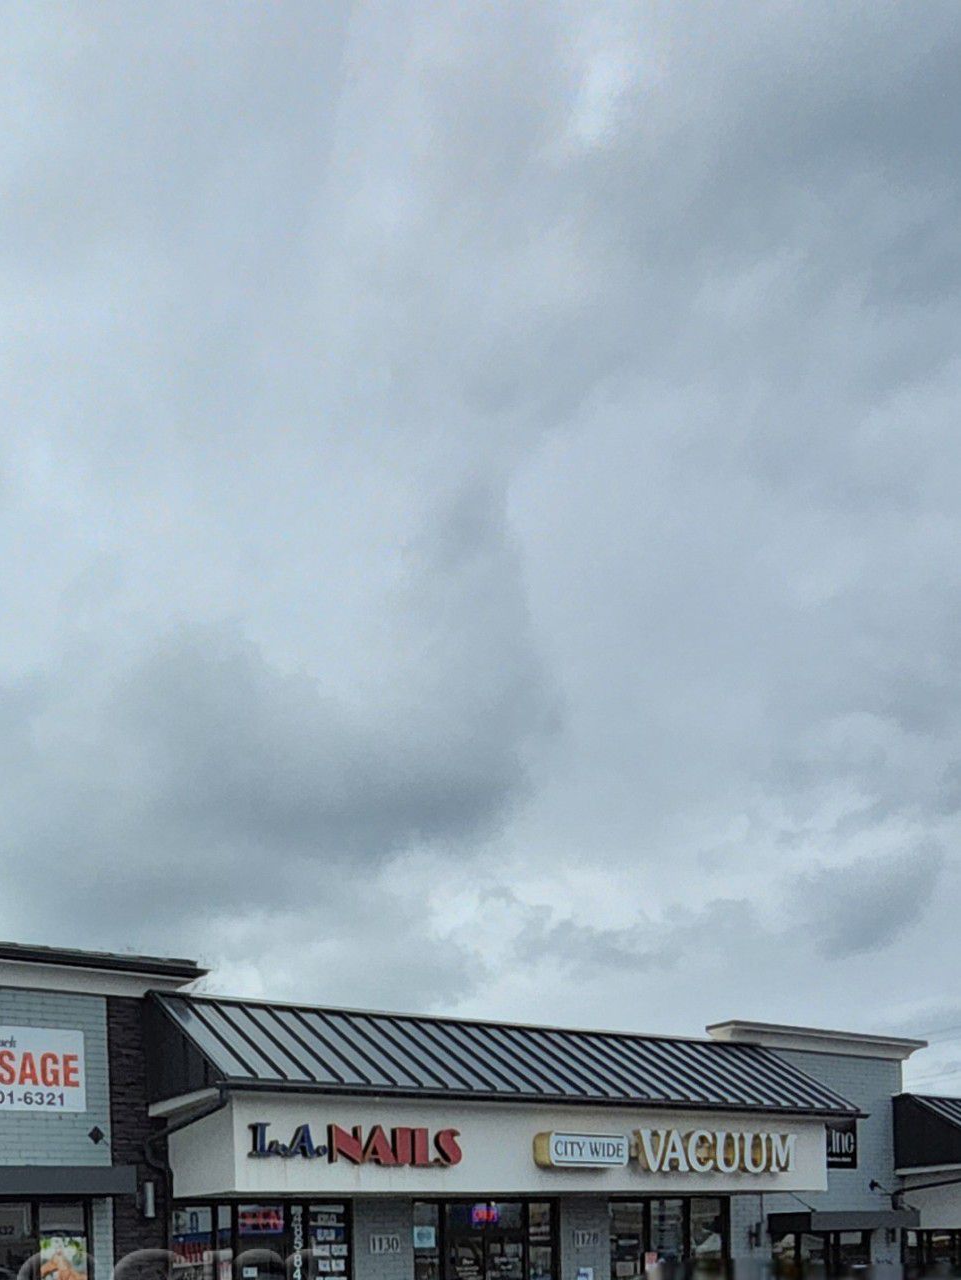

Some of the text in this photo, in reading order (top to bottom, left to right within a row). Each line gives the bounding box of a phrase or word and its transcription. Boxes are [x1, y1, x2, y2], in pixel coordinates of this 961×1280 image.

[327, 1123, 462, 1168] NAILS
[554, 1140, 625, 1158] CITY WIDE
[635, 1128, 798, 1174] VACUUM
[371, 1236, 399, 1252] 1130
